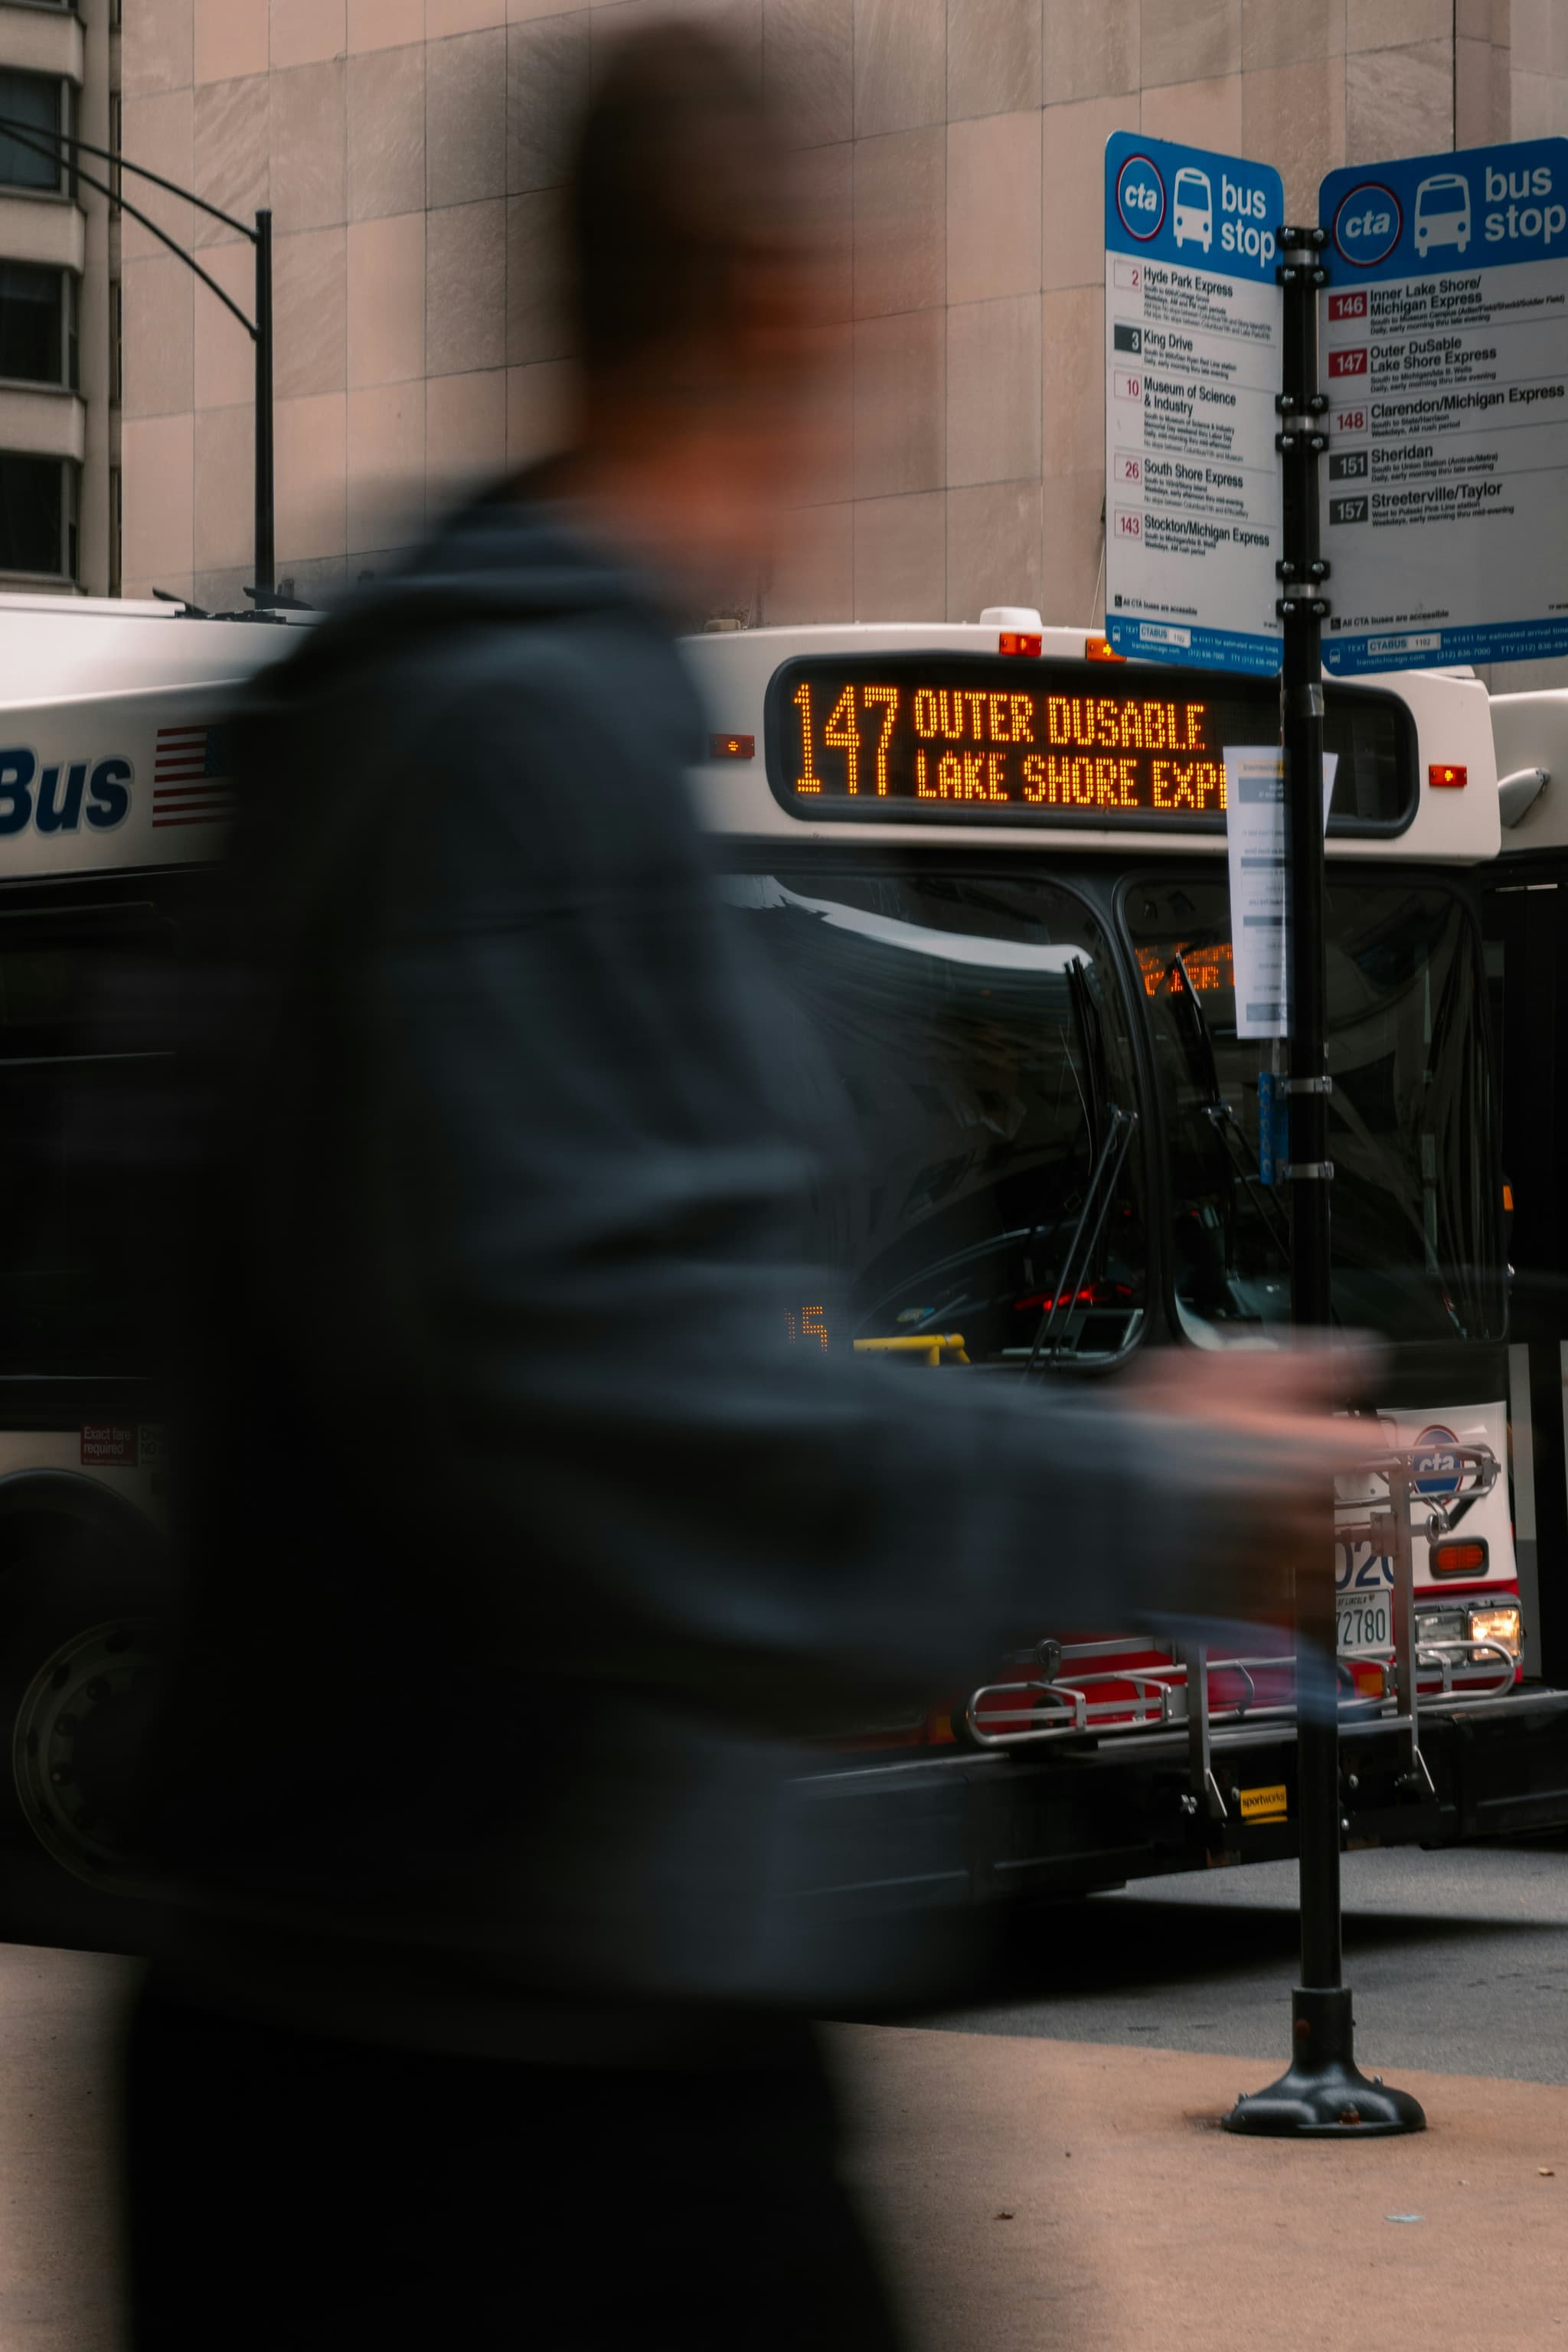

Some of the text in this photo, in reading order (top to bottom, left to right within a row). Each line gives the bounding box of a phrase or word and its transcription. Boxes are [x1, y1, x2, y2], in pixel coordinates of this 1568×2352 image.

[1125, 183, 1157, 211] cta
[1222, 175, 1266, 218] bus
[1485, 167, 1553, 202] bus
[1345, 211, 1390, 239] cta
[1485, 204, 1567, 244] stop
[1222, 219, 1275, 267] stop
[1132, 270, 1138, 286] 2
[1144, 266, 1168, 285] Hyde
[1171, 272, 1192, 288] Park
[1195, 277, 1233, 297] Express
[1337, 276, 1481, 315] 146 Inner Lake Shore/
[1370, 291, 1482, 316] Michigan Express
[1132, 330, 1193, 351] 3 King Drive
[1337, 336, 1462, 372] 147 Outer DuSable
[1370, 348, 1497, 374] Lake Shore Express
[1127, 376, 1236, 406] 10 Museum of Science
[1144, 395, 1193, 417] & Industry
[1338, 385, 1564, 430] 148 Clarendon/Michigan Express
[1125, 461, 1138, 479] 26
[1145, 459, 1172, 477] South
[1175, 463, 1203, 482] Shore
[1206, 469, 1243, 488] Express
[1340, 445, 1433, 475] 151 Sheridan
[1338, 482, 1503, 521] 157 Streeterville/Taylor
[1120, 517, 1139, 534] 143
[1145, 514, 1230, 542] Stockton/Michigan
[1233, 528, 1269, 547] Express
[1342, 618, 1352, 627] All
[1354, 616, 1369, 626] CTA
[1371, 613, 1393, 624] buses
[1409, 608, 1449, 619] accessible
[1141, 626, 1168, 640] CTABUS
[1370, 639, 1406, 652] CTABUS
[914, 688, 1206, 751] OUTER DUSABLE
[794, 683, 900, 795] 147
[0, 746, 133, 836] Bus
[916, 748, 1008, 802] LAKE
[1022, 753, 1139, 807] SHORE
[83, 1426, 110, 1440] Exact
[83, 1442, 123, 1456] required
